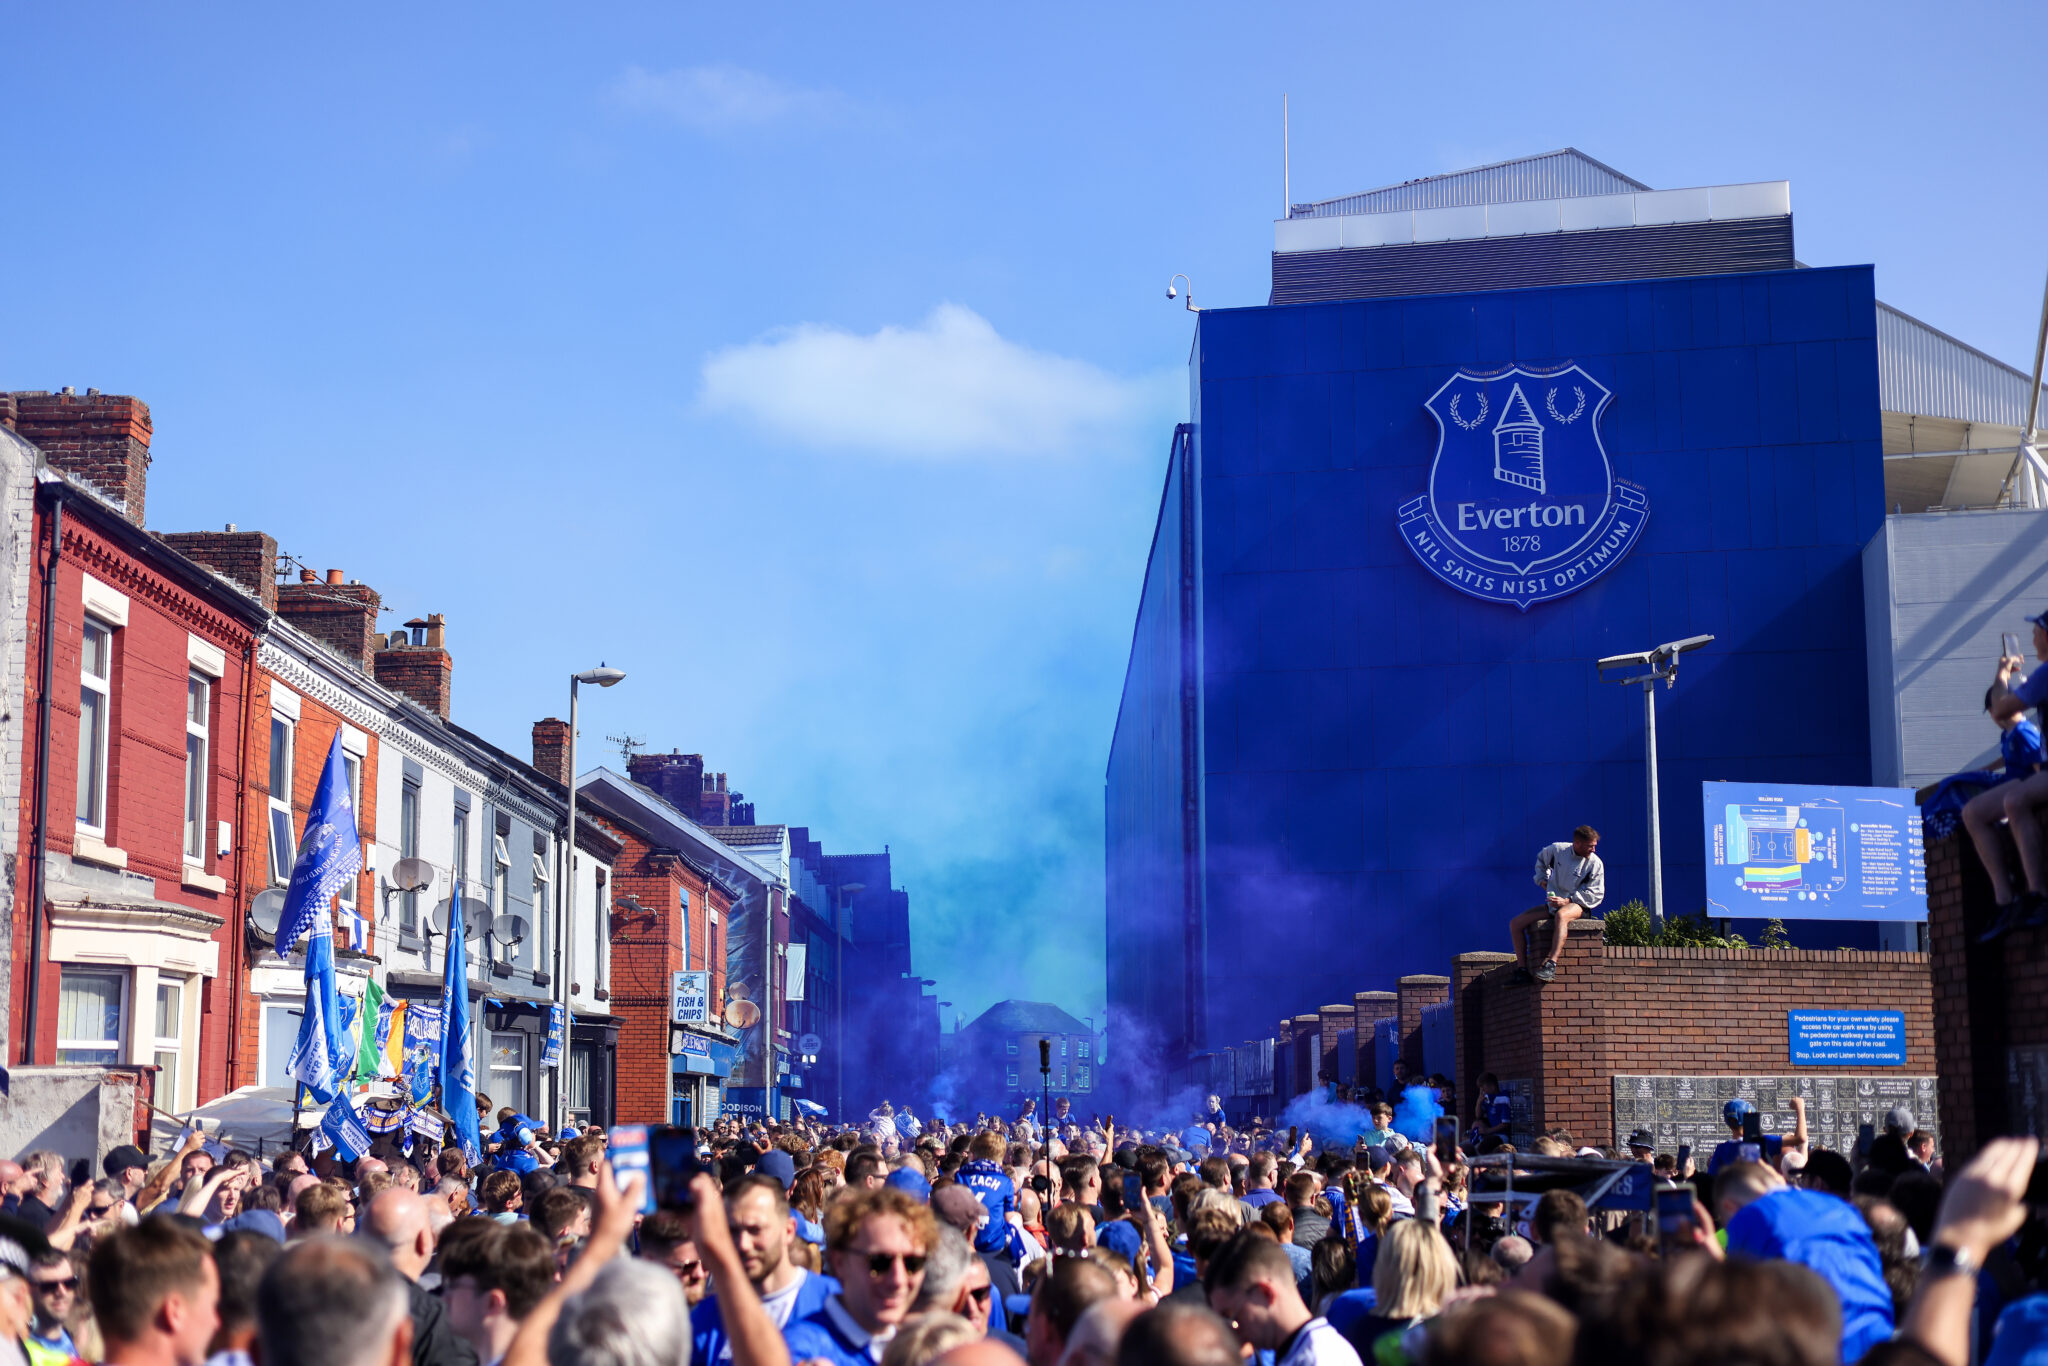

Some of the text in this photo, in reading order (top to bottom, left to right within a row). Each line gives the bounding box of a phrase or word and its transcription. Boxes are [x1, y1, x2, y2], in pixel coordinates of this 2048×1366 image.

[1458, 502, 1585, 530] Everton
[1502, 535, 1541, 552] 1878
[1415, 520, 1631, 594] NIL SATIS NISI OPTIMUM
[677, 997, 704, 1008] FISH &
[678, 1009, 702, 1020] CHIPS
[1863, 1015, 1880, 1023] safety
[970, 1174, 1001, 1191] ZACH
